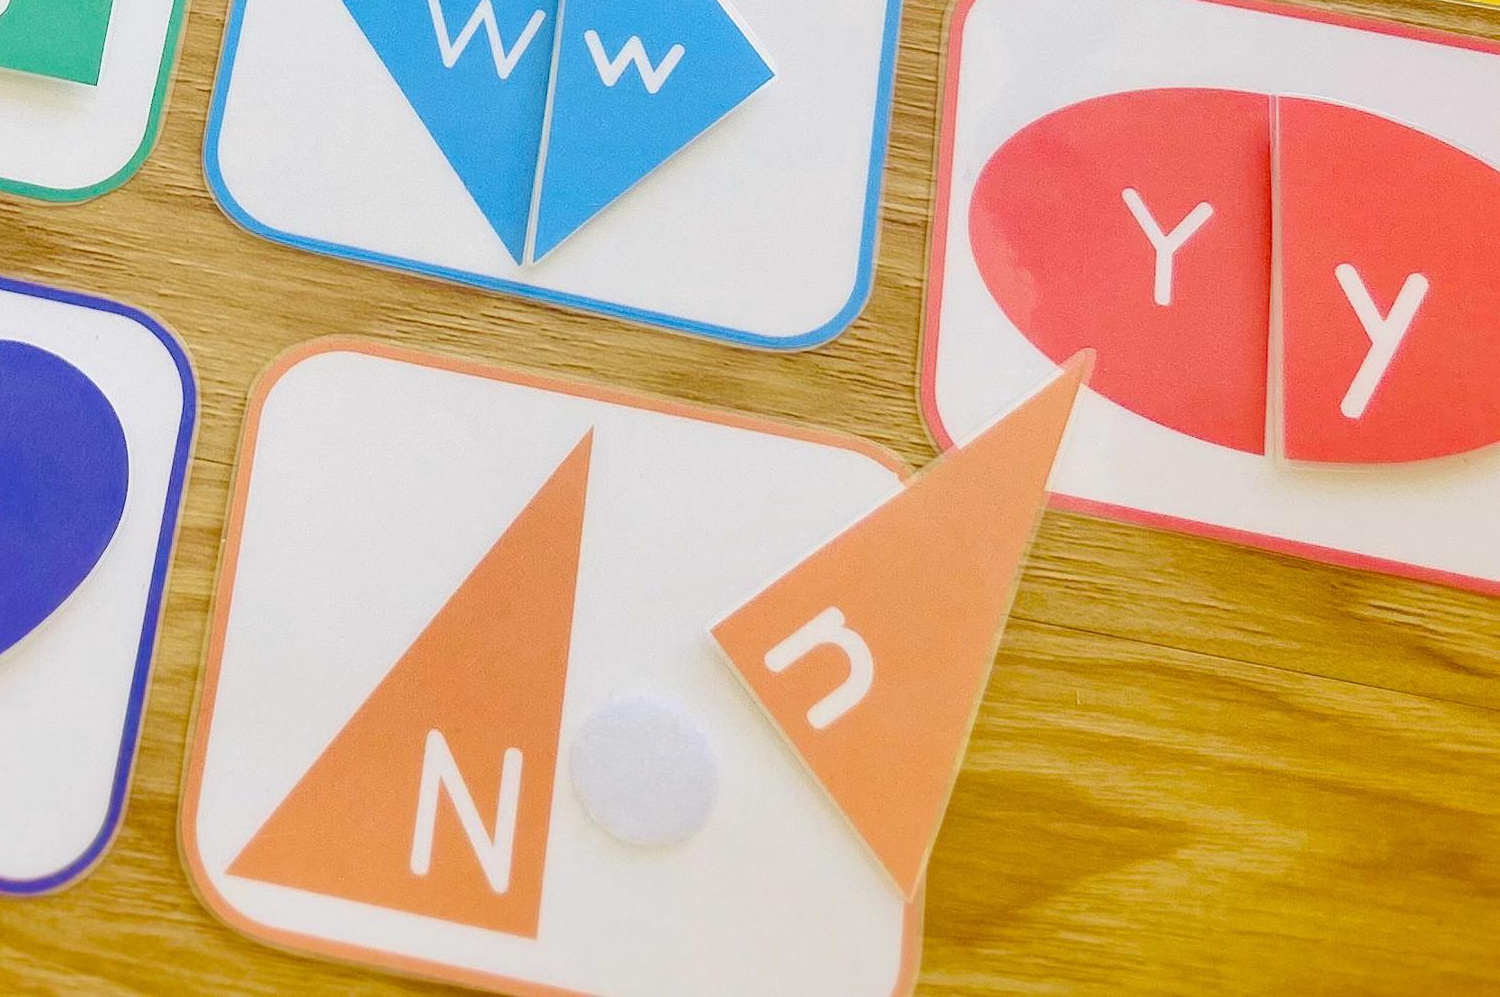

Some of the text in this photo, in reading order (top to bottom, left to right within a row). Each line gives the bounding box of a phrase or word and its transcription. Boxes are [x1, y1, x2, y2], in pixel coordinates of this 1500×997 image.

[583, 29, 686, 95] w
[1121, 187, 1430, 420] Y y
[409, 606, 875, 895] N n
